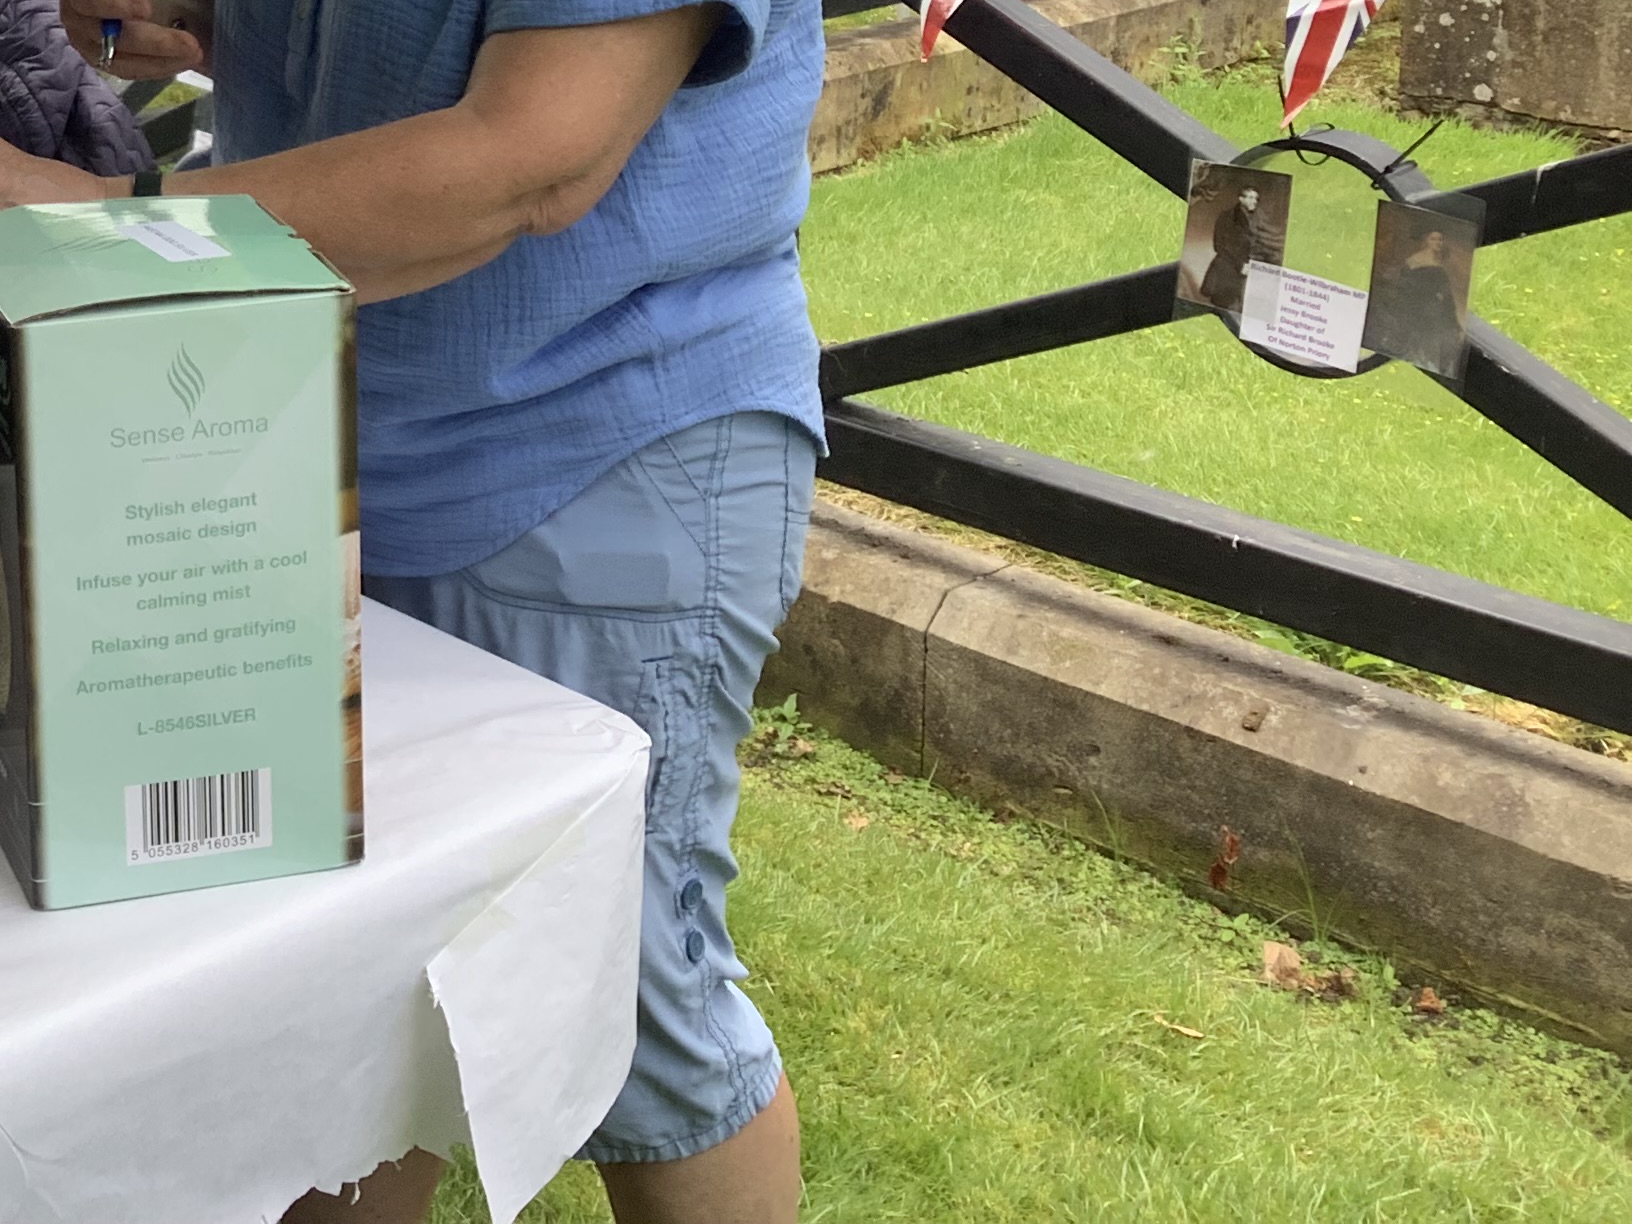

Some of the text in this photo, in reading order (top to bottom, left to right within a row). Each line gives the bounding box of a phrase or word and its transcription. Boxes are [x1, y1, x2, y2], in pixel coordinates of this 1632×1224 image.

[1290, 295, 1321, 311] Married
[1280, 316, 1326, 335] Daughter of
[1301, 310, 1328, 324] Brooke
[1266, 323, 1335, 349] Sir Richard Brooke
[1279, 338, 1306, 353] Norton
[1307, 347, 1331, 361] Priory
[110, 416, 269, 449] Sense Aroma
[124, 492, 257, 521] Stylish elegant
[126, 519, 257, 547] mosaic design
[76, 550, 308, 591] Infuse your air with a cool
[136, 584, 251, 611] calming mist
[91, 618, 296, 655] Relaxing and gratifying
[76, 654, 313, 695] Aromatherapeutic benefits
[136, 708, 257, 736] L-8546SILVER
[131, 834, 255, 861] 5 055328 160351
